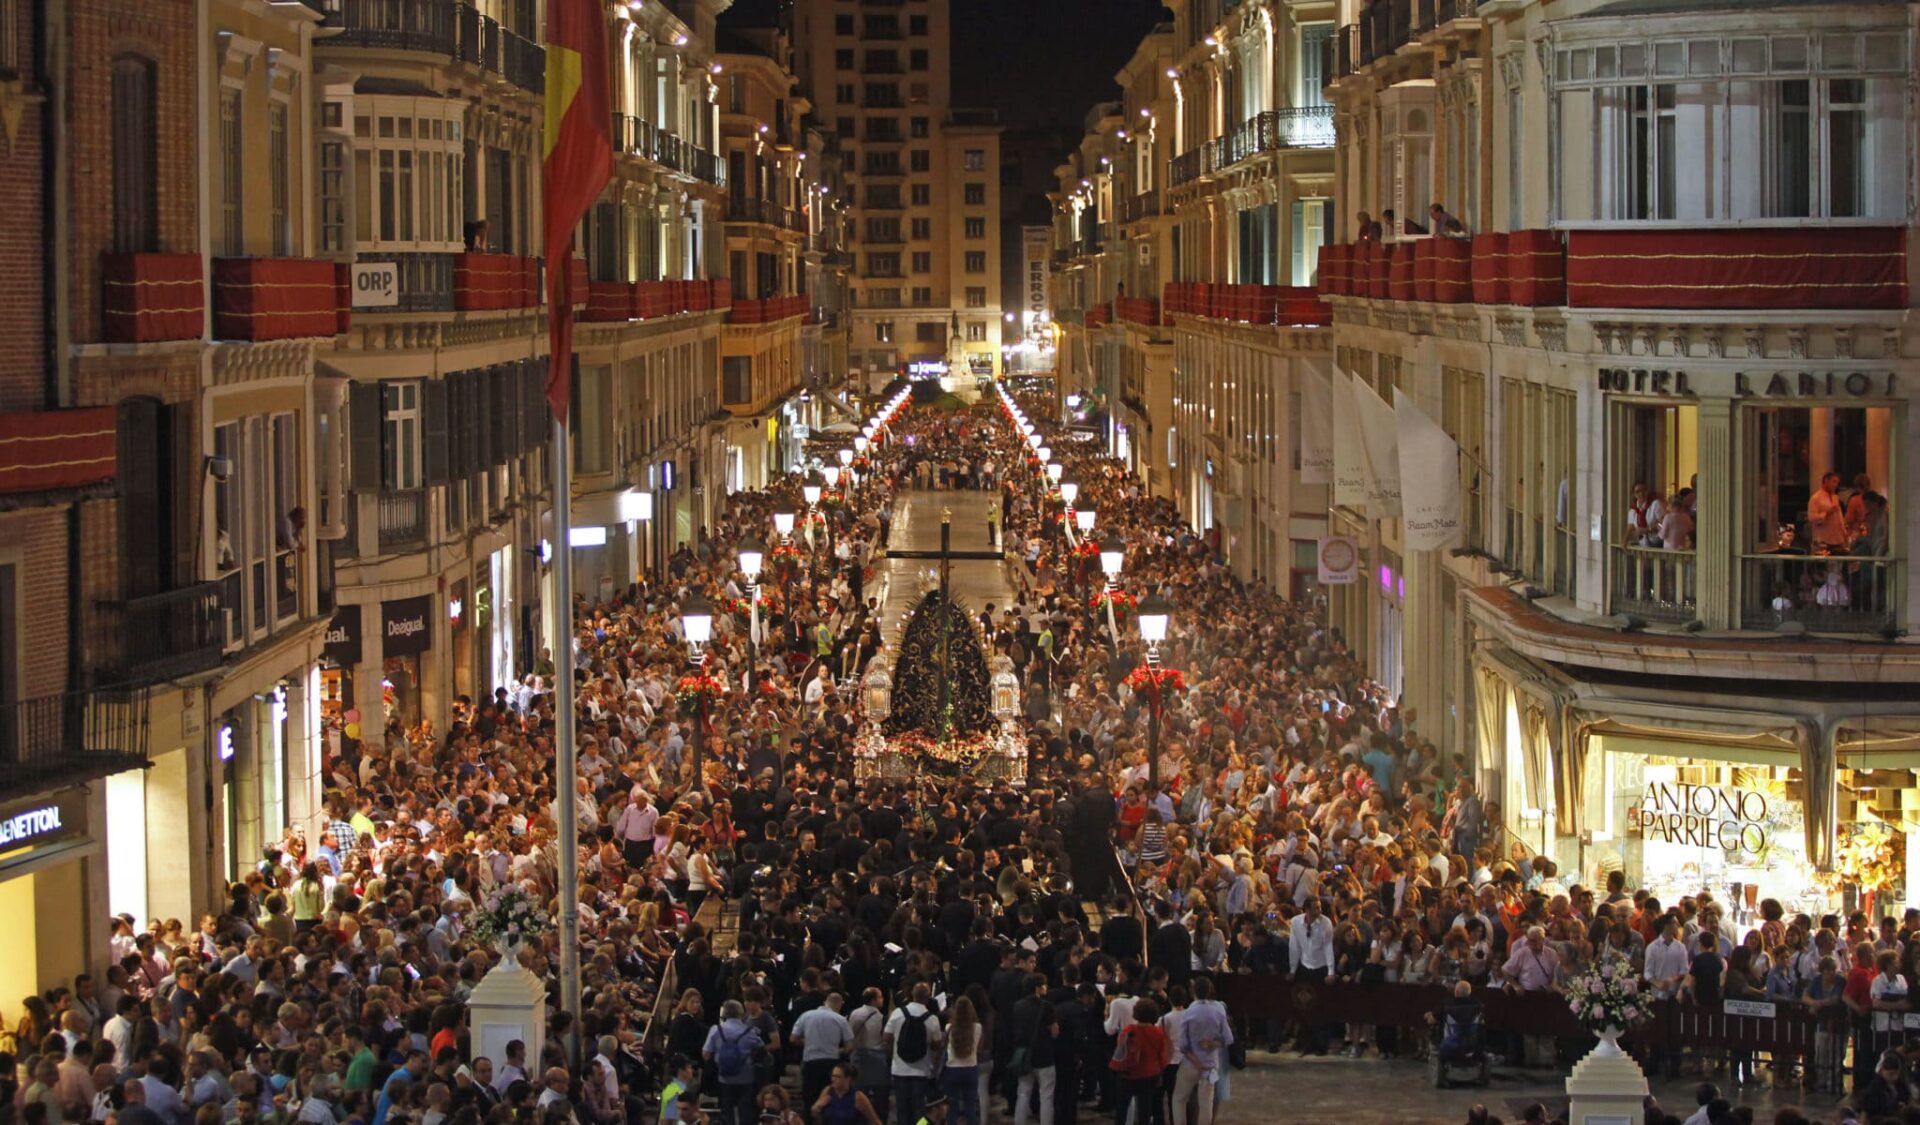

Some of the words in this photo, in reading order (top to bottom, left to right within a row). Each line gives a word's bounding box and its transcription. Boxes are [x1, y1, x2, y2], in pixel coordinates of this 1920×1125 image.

[1598, 367, 1695, 395] HOTEL
[1735, 371, 1897, 397] LARIOS
[1641, 780, 1767, 822] ANTONIO
[1640, 810, 1765, 854] PARRIEGO
